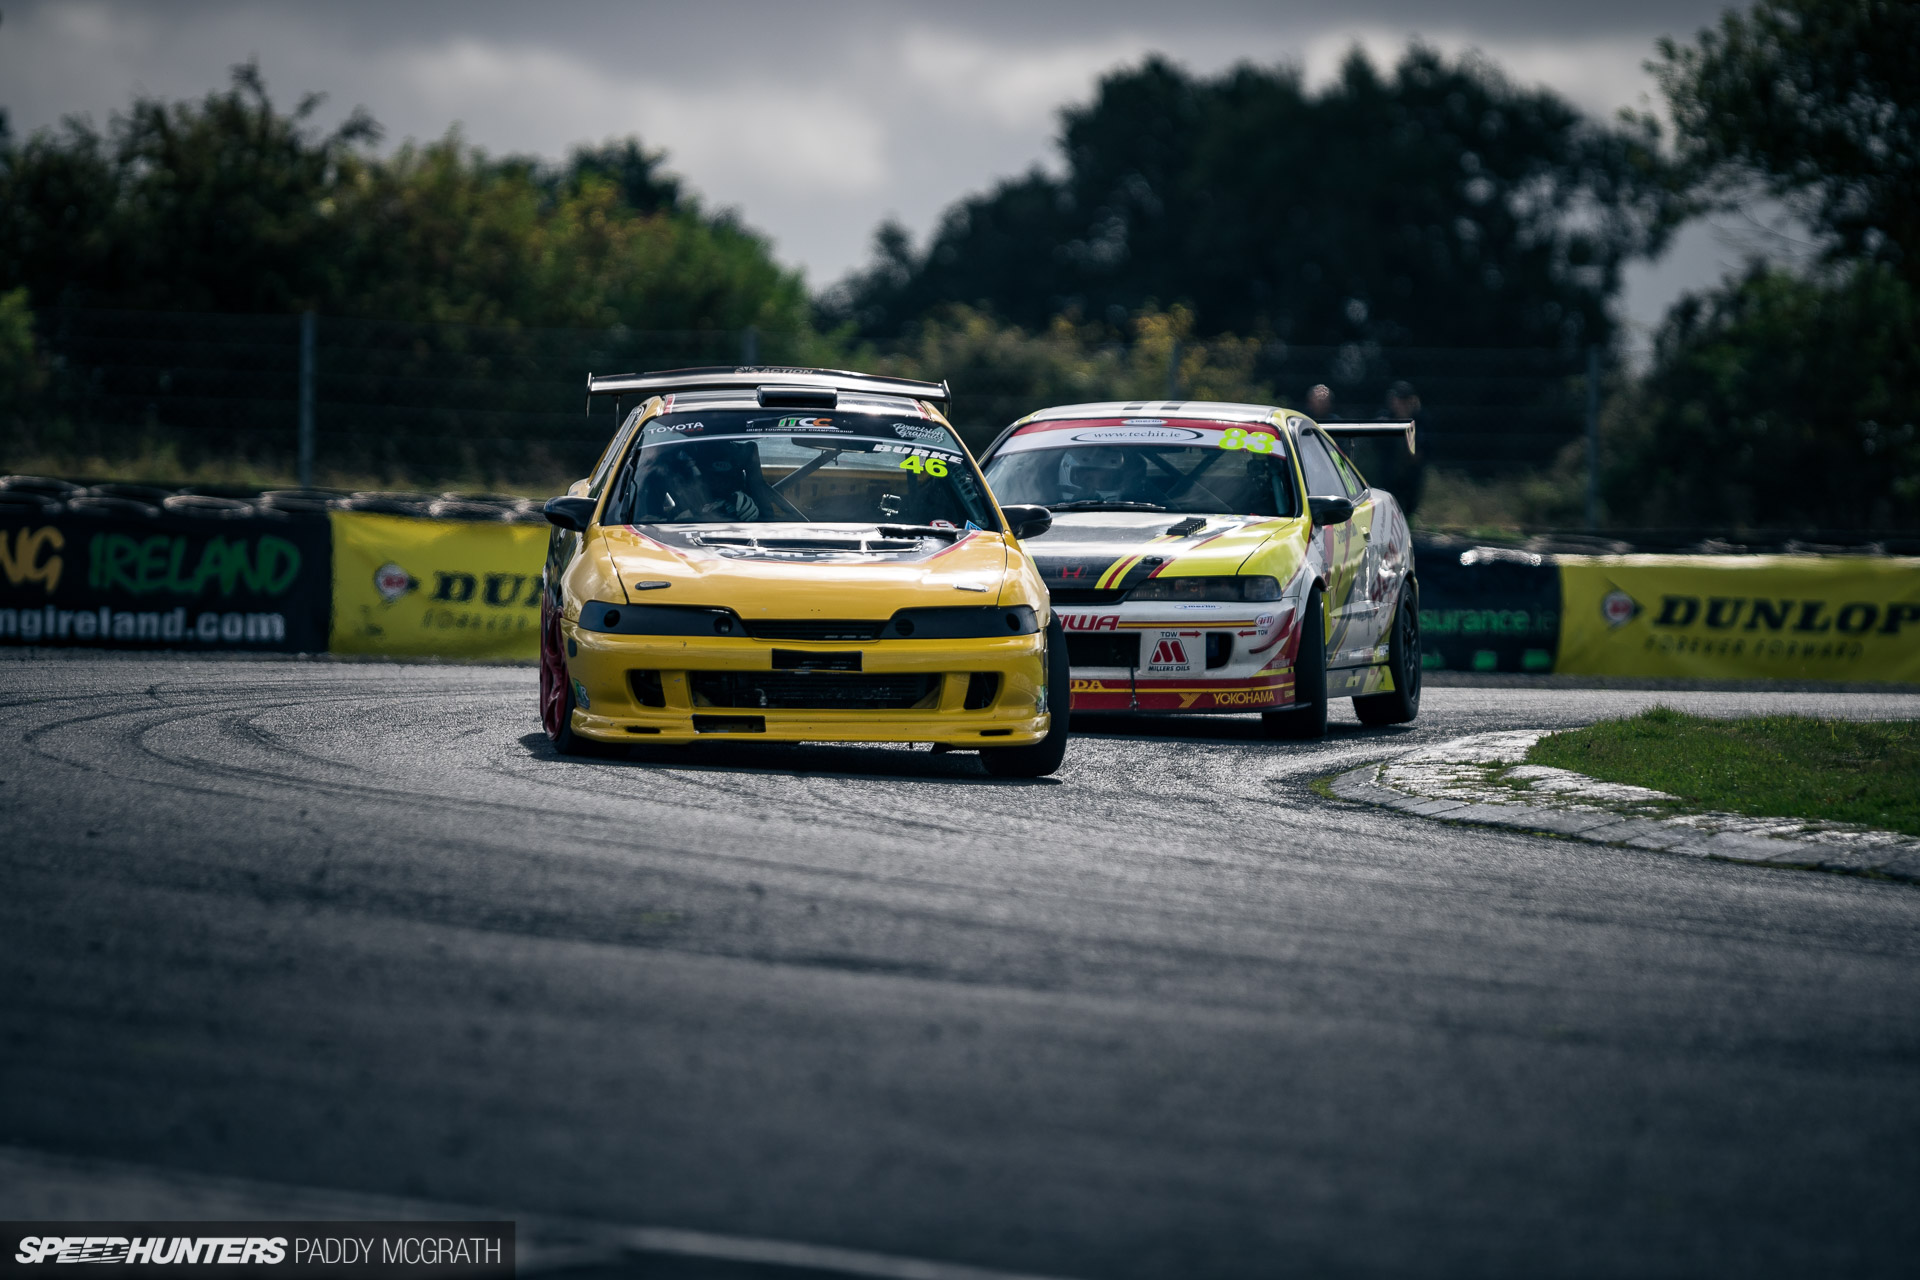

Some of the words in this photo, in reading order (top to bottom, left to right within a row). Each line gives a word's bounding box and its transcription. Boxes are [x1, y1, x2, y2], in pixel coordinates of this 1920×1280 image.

[648, 422, 704, 434] TOYOTA
[778, 417, 833, 427] ITCC
[1094, 430, 1181, 438] www.techit.ie
[1219, 428, 1276, 454] 83
[873, 444, 964, 464] BURKE
[900, 455, 949, 478] 46
[89, 533, 300, 594] IRELAND
[1653, 594, 1920, 636] DUNLOP
[1213, 691, 1275, 704] YOKOHAMA
